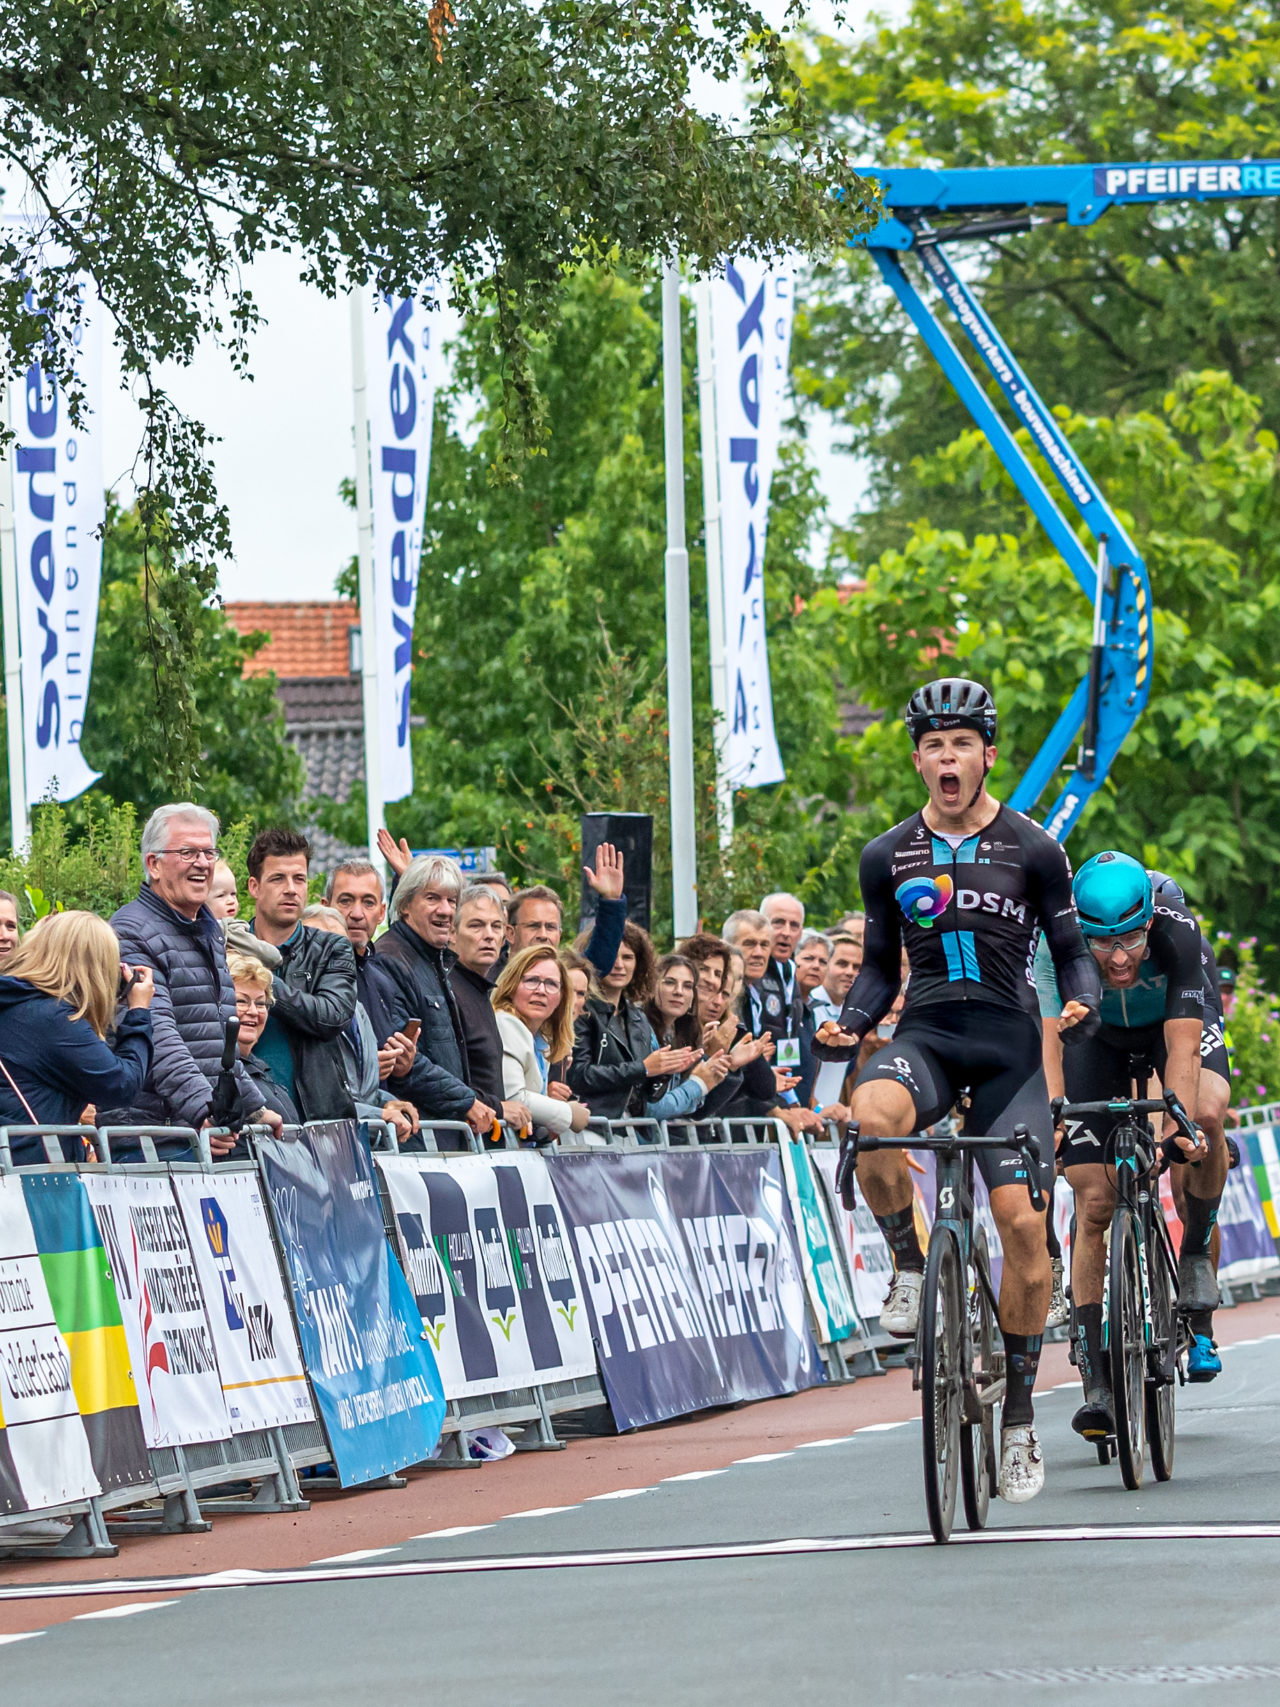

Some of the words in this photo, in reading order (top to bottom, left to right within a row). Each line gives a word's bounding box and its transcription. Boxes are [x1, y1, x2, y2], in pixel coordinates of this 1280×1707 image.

[946, 282, 1014, 384] hoogwerkers
[1013, 389, 1091, 505] bouwmachines
[956, 888, 1026, 925] DSM
[308, 1283, 364, 1379] JAWS
[574, 1219, 704, 1358] PFEIFER
